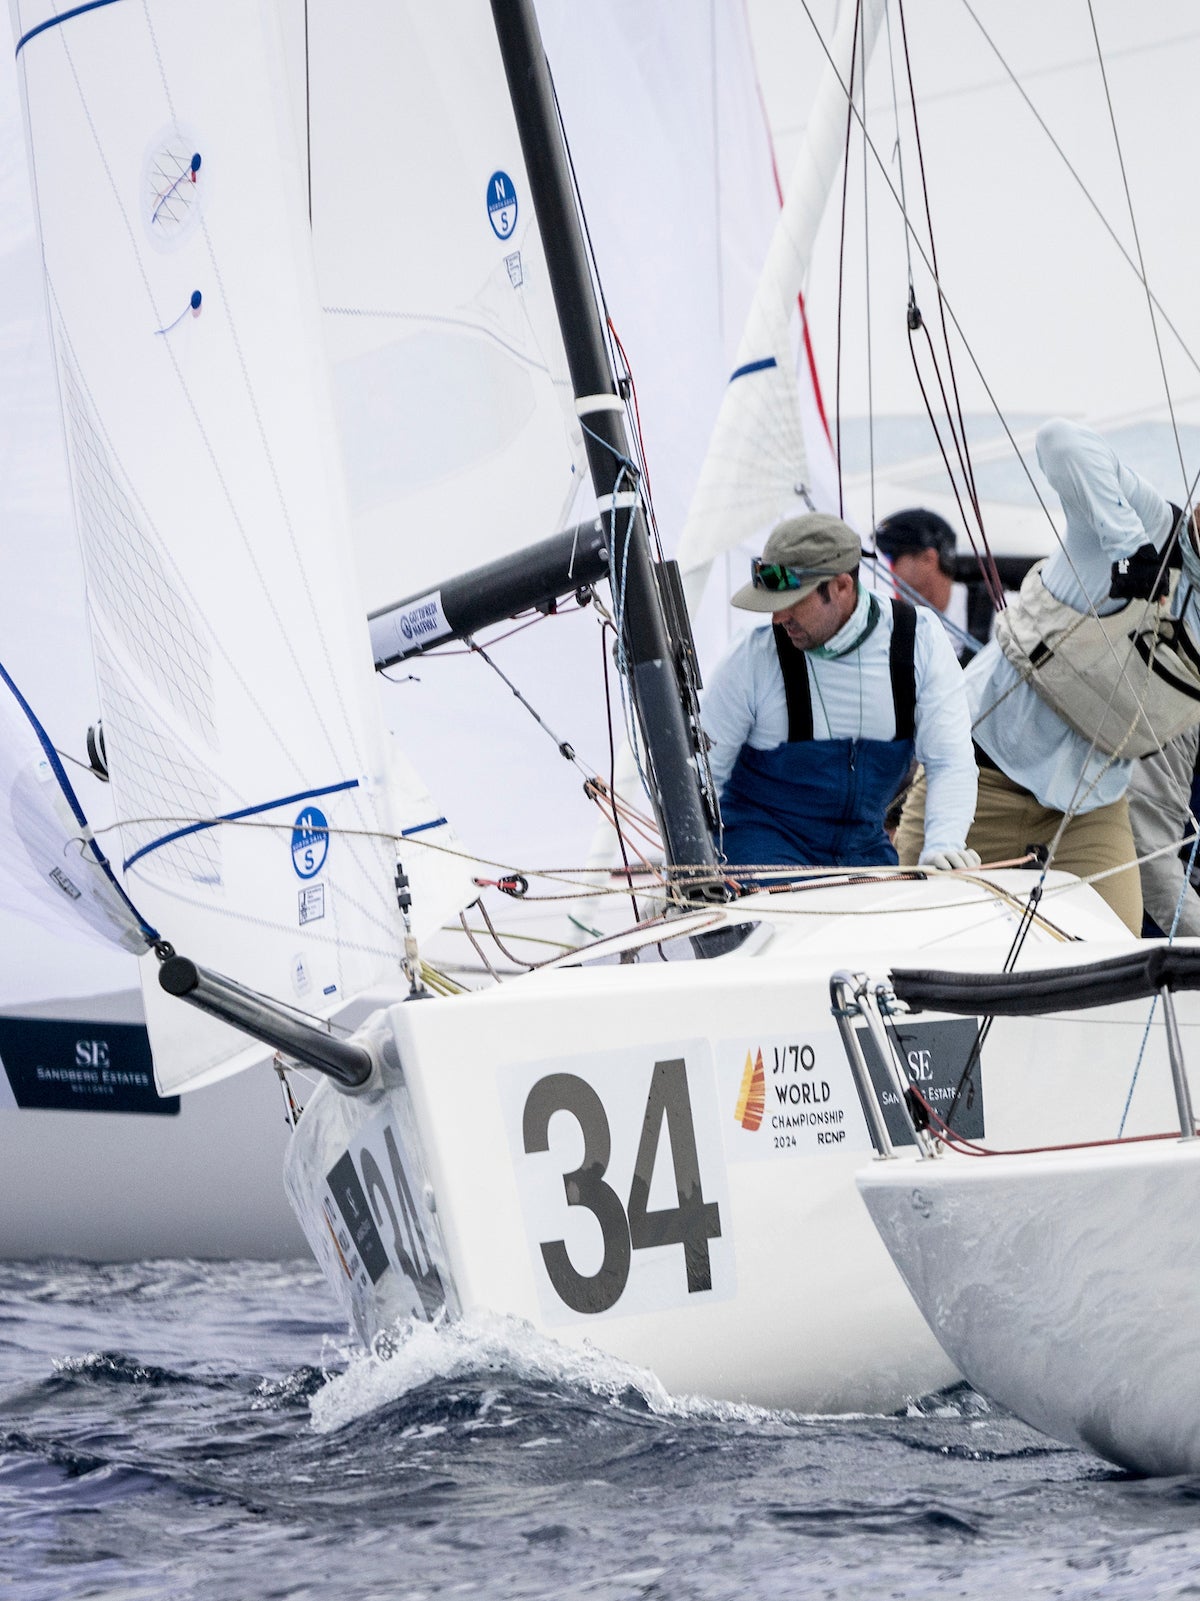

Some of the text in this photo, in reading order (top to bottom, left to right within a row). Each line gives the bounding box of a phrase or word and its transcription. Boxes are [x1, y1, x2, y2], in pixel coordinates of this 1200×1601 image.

[494, 178, 506, 200] N
[501, 211, 508, 231] S
[302, 814, 313, 838] N
[305, 849, 314, 870] S
[75, 1040, 110, 1068] SE
[773, 1045, 815, 1074] J/70
[907, 1049, 934, 1081] SE
[102, 1069, 149, 1086] ESTATES
[775, 1081, 831, 1105] WORLD
[772, 1110, 845, 1129] CHAMPIONSHIP
[774, 1130, 846, 1149] 2024 RCNP
[522, 1057, 722, 1314] 34
